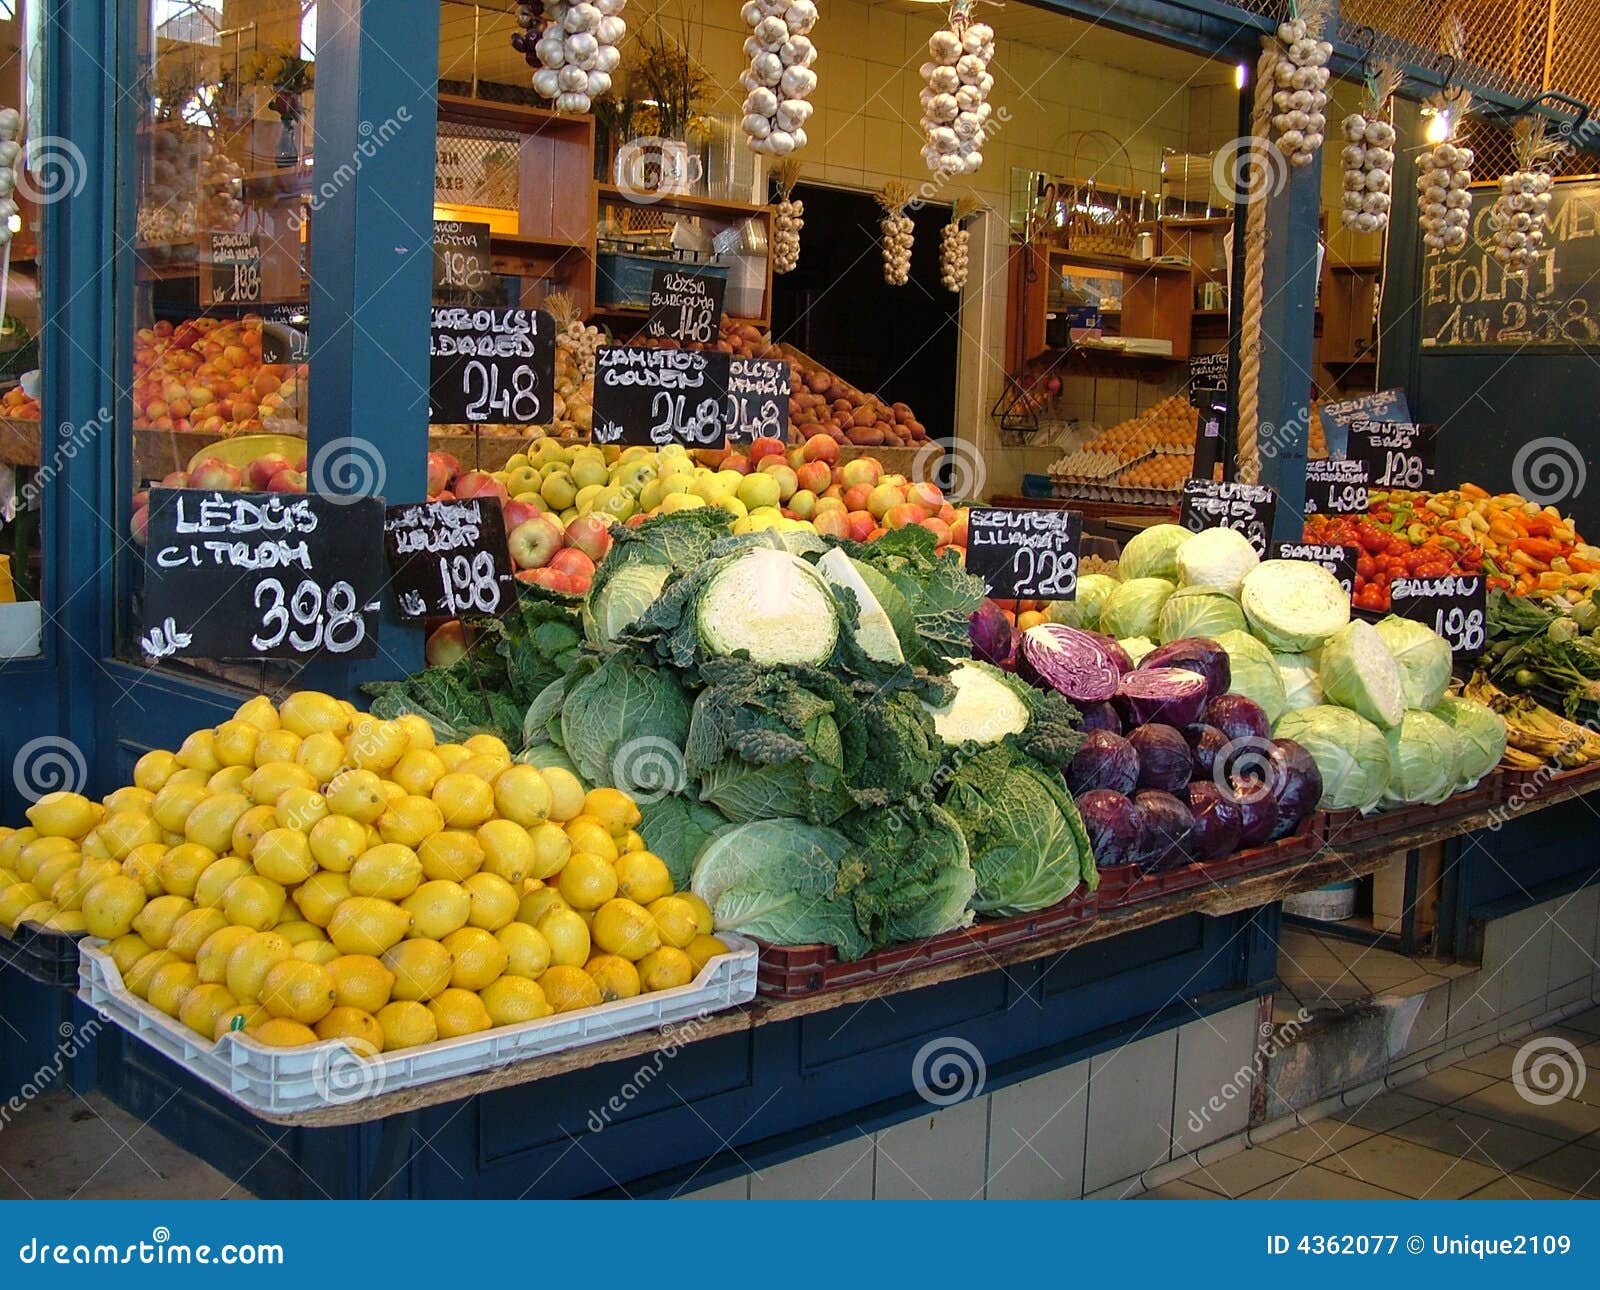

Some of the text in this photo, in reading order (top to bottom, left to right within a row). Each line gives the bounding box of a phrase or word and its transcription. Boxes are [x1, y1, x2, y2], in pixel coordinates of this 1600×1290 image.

[463, 360, 541, 421] 248
[1327, 484, 1369, 513] 498
[1013, 546, 1077, 597] 228
